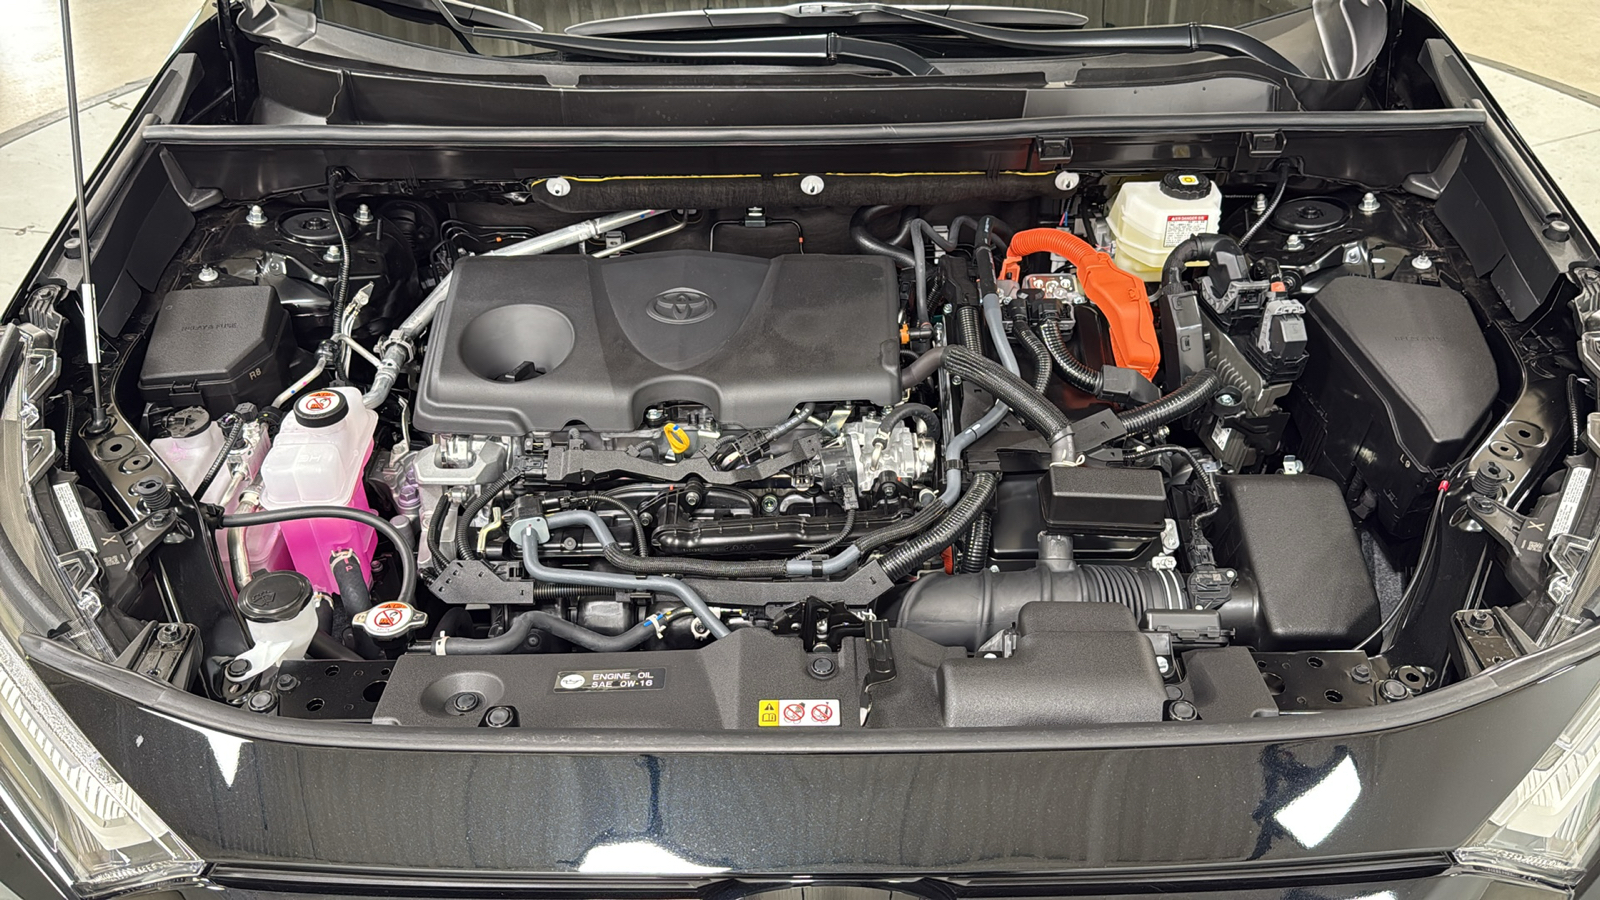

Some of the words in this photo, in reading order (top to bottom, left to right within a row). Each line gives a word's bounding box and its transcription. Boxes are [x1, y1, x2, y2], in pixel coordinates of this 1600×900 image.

[248, 367, 262, 381] R8
[592, 672, 631, 680] ENGINE
[637, 671, 654, 679] OIL
[591, 680, 613, 688] SAE
